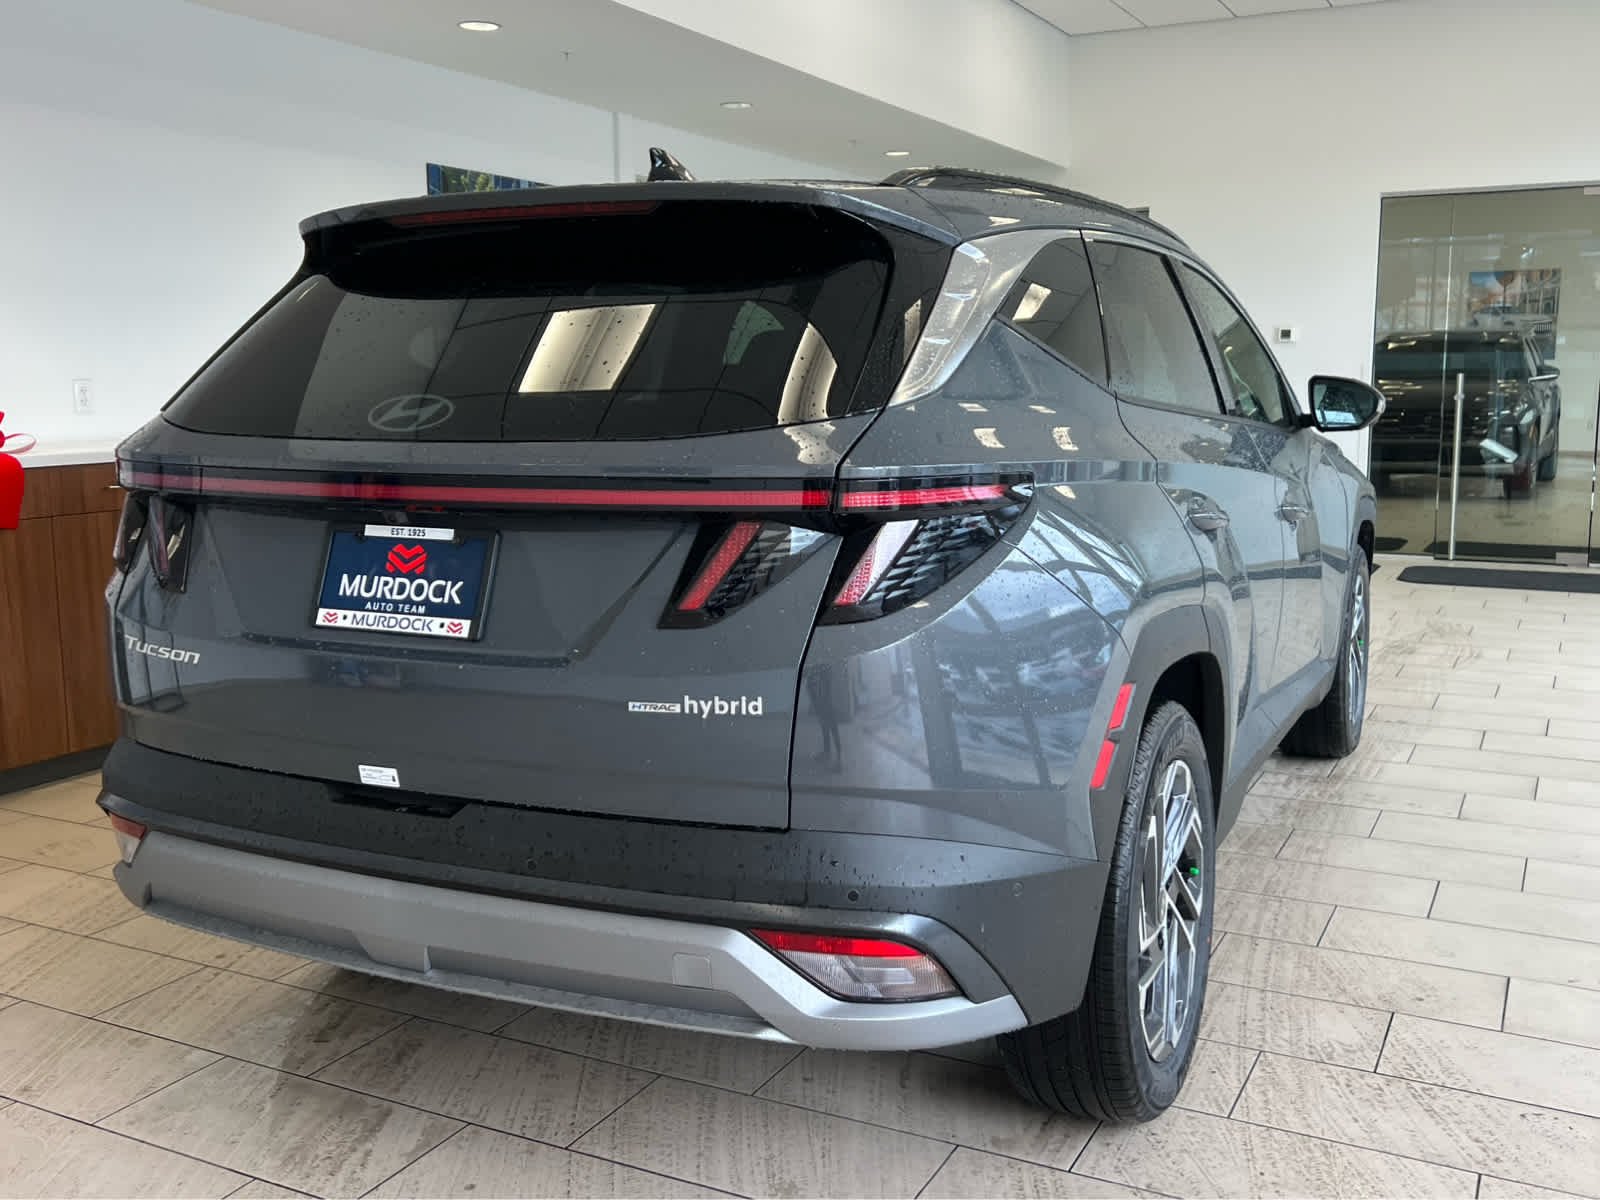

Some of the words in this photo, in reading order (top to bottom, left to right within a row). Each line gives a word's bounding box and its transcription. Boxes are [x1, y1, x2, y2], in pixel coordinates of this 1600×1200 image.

[390, 527, 407, 537] EST.
[408, 528, 427, 538] 1925
[338, 573, 464, 605] MURDOCK
[365, 601, 393, 612] AUTO
[397, 603, 426, 614] TEAM
[351, 613, 435, 632] MURDOCK
[629, 702, 679, 712] HTRAC
[683, 694, 763, 719] hybrid
